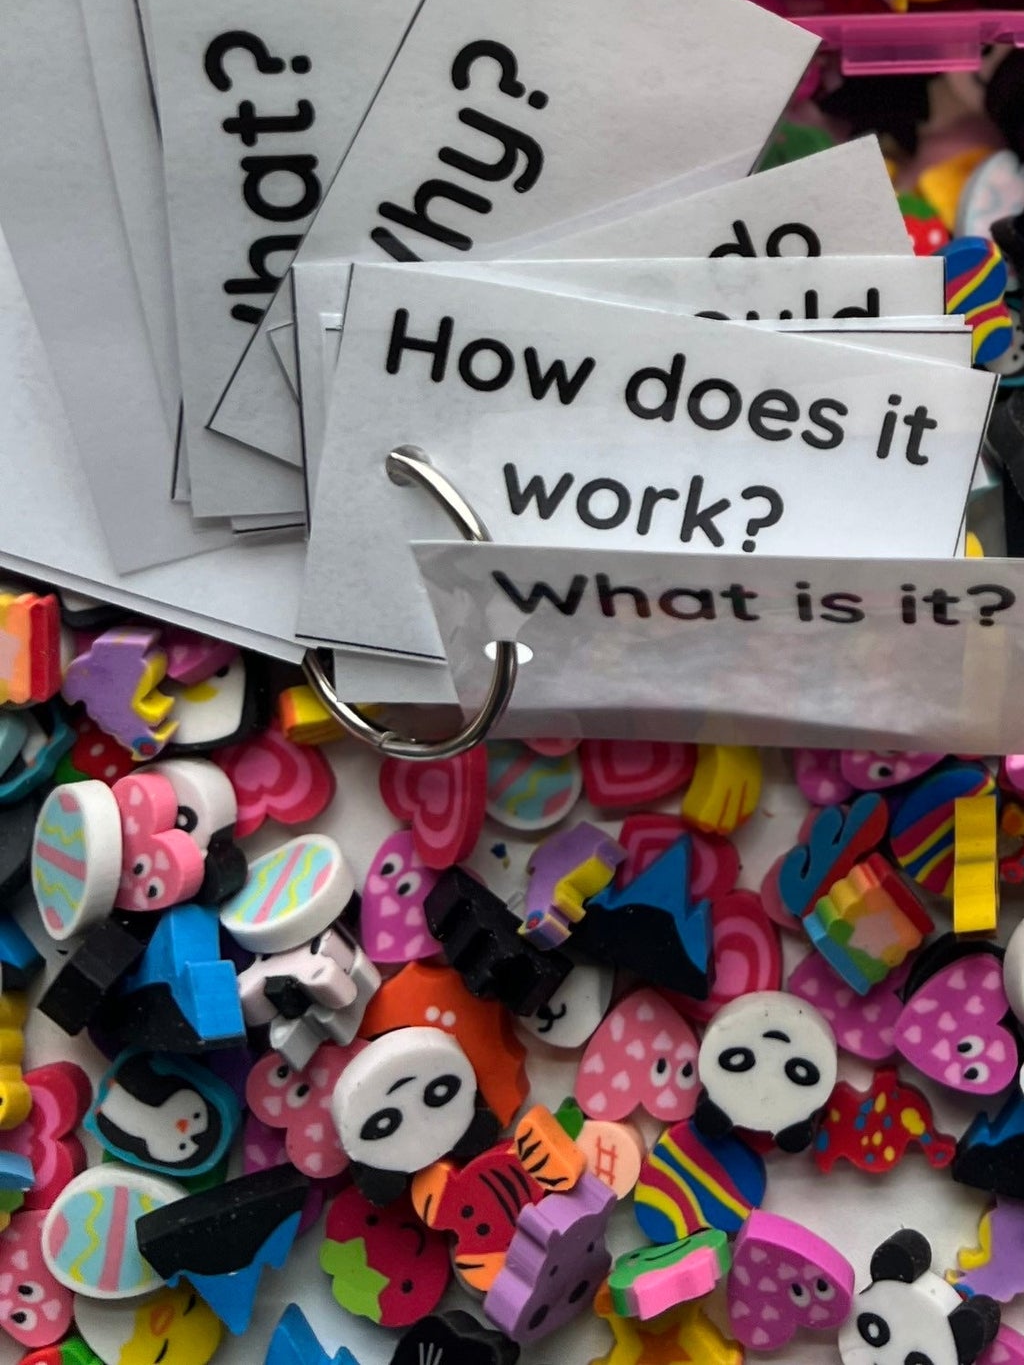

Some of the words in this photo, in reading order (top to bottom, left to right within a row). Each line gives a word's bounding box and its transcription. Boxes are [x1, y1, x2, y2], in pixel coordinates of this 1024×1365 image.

[204, 30, 323, 326] hat?
[385, 307, 596, 406] How
[624, 352, 849, 450] does
[876, 393, 938, 466] it
[503, 462, 784, 553] work?
[491, 569, 761, 622] What
[795, 580, 866, 625] is
[900, 583, 1016, 627] it?
